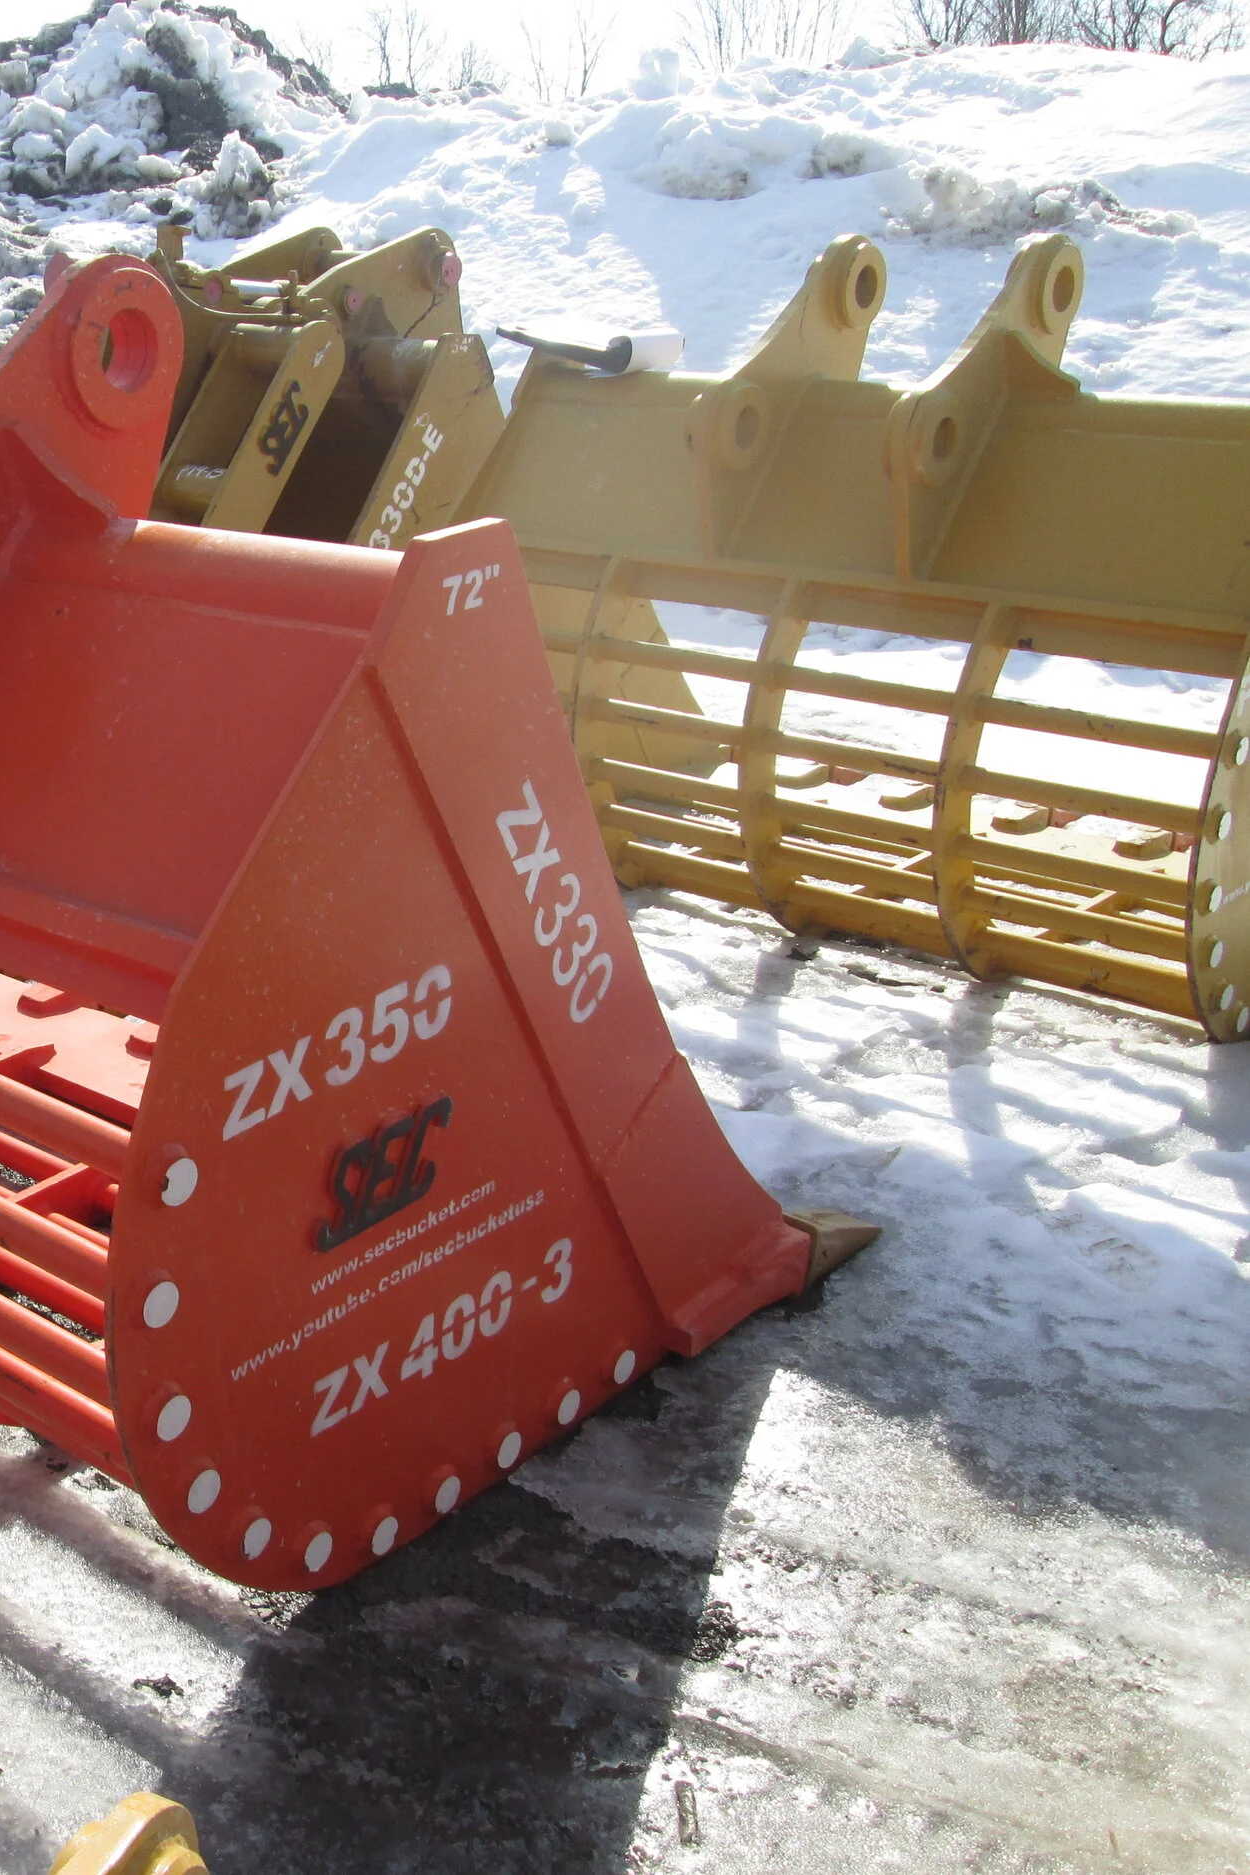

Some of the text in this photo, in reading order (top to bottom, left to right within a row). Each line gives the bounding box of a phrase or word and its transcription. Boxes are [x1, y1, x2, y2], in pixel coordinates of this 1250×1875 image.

[442, 563, 500, 616] 72"
[496, 779, 613, 1023] ZX330
[223, 964, 452, 1141] ZX 350
[310, 1179, 497, 1295] www.secbucket.com
[316, 1096, 452, 1253] SEC
[310, 1238, 574, 1438] ZX 400-3
